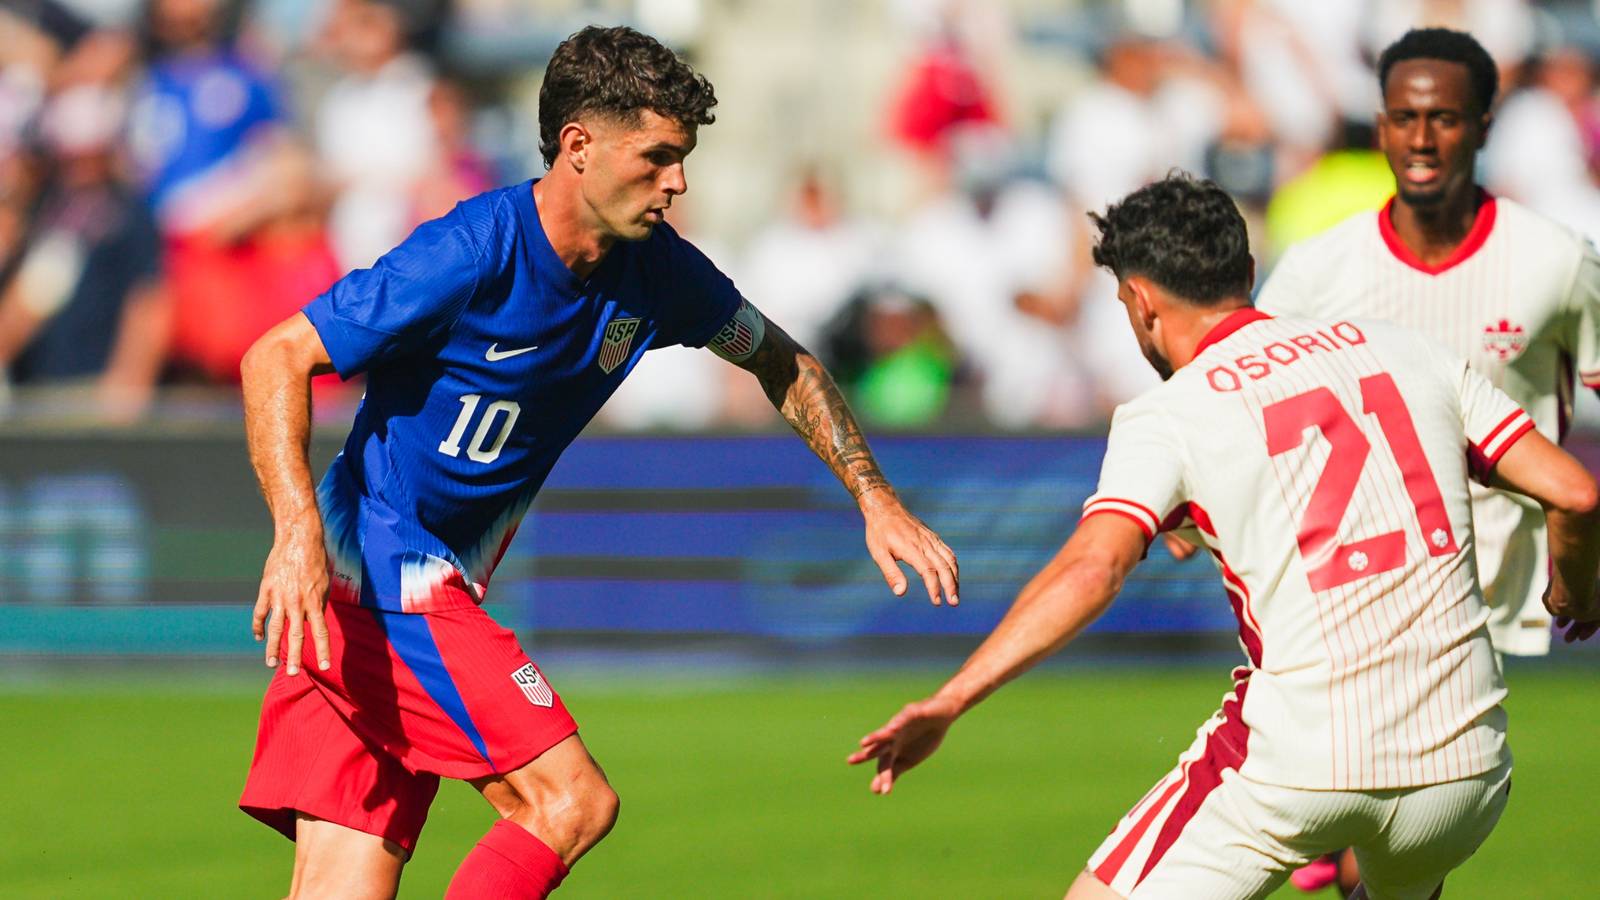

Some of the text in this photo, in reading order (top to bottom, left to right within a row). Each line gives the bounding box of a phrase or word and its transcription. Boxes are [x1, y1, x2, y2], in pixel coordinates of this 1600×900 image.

[606, 322, 637, 343] USA
[711, 318, 738, 346] USA
[1205, 321, 1367, 393] OSORIO
[438, 393, 521, 464] 10
[1262, 371, 1460, 594] 21
